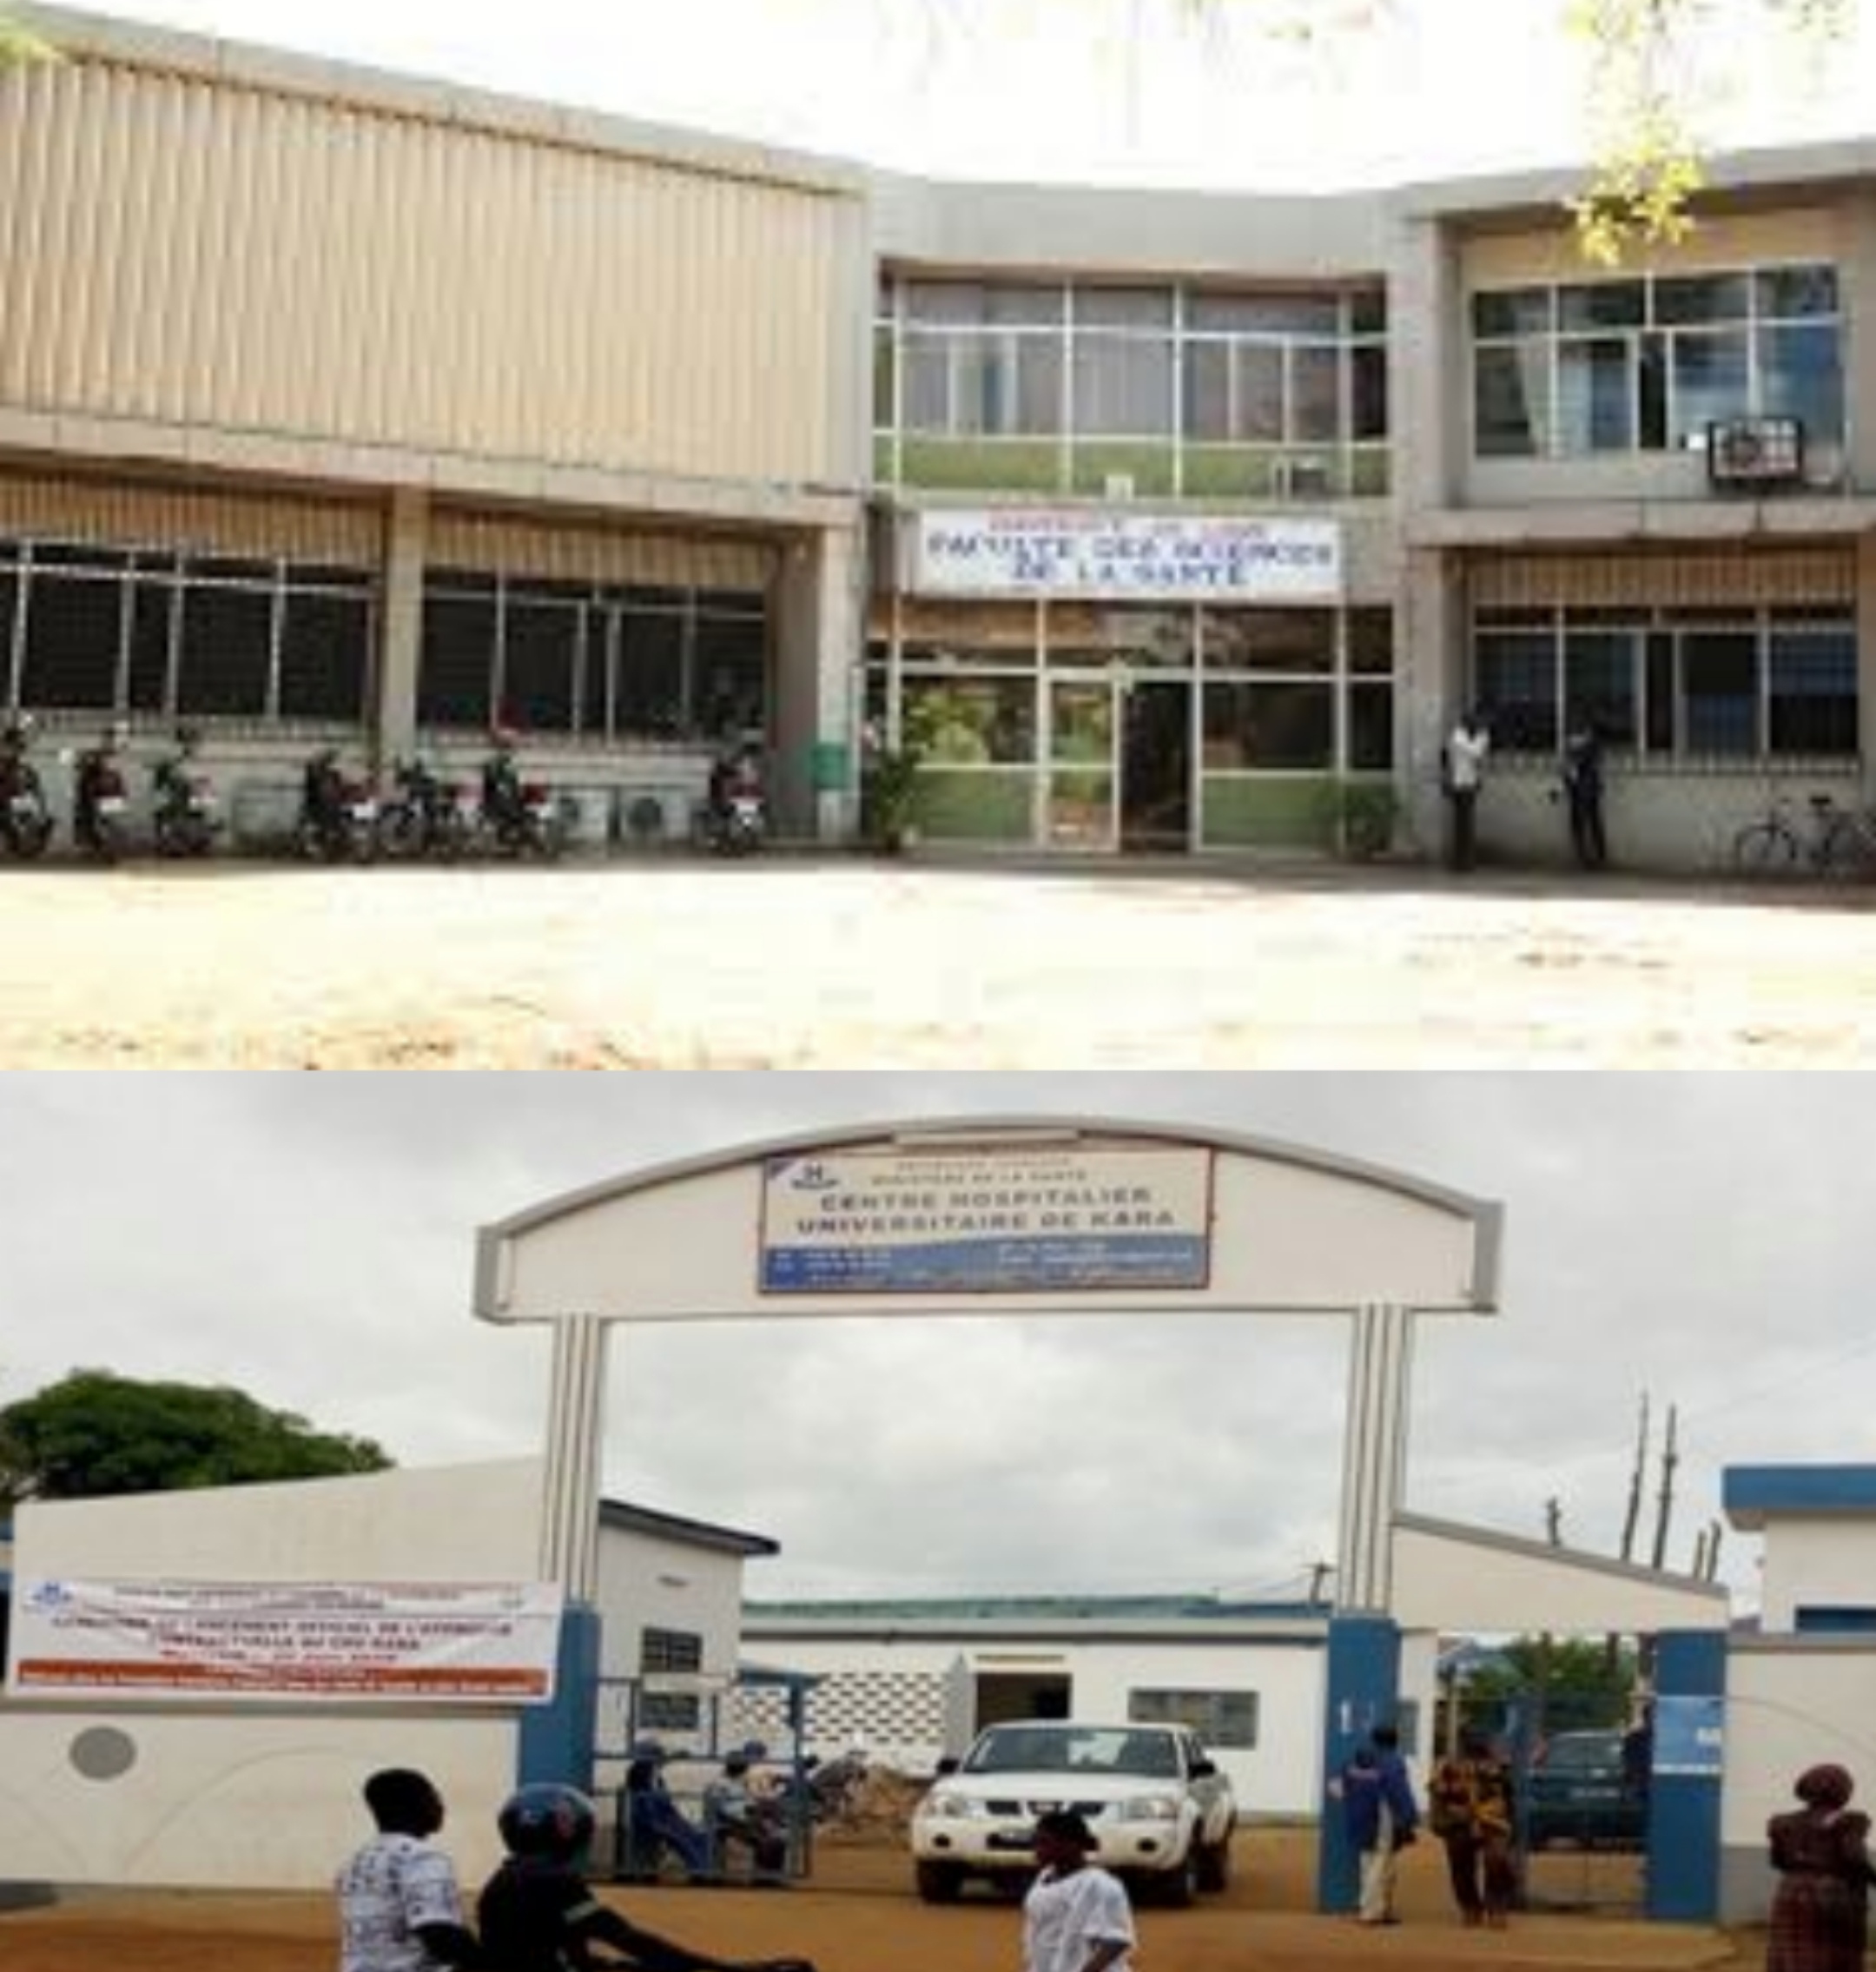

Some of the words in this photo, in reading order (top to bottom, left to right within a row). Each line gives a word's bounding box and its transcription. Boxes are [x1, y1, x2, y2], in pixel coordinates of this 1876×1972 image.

[821, 1191, 939, 1213] CENTRE
[949, 1187, 1153, 1209] HOSPITALIER
[796, 1211, 1025, 1235] UNIVERSITAIRE
[1040, 1211, 1075, 1229] DE
[1090, 1208, 1177, 1228] KARA
